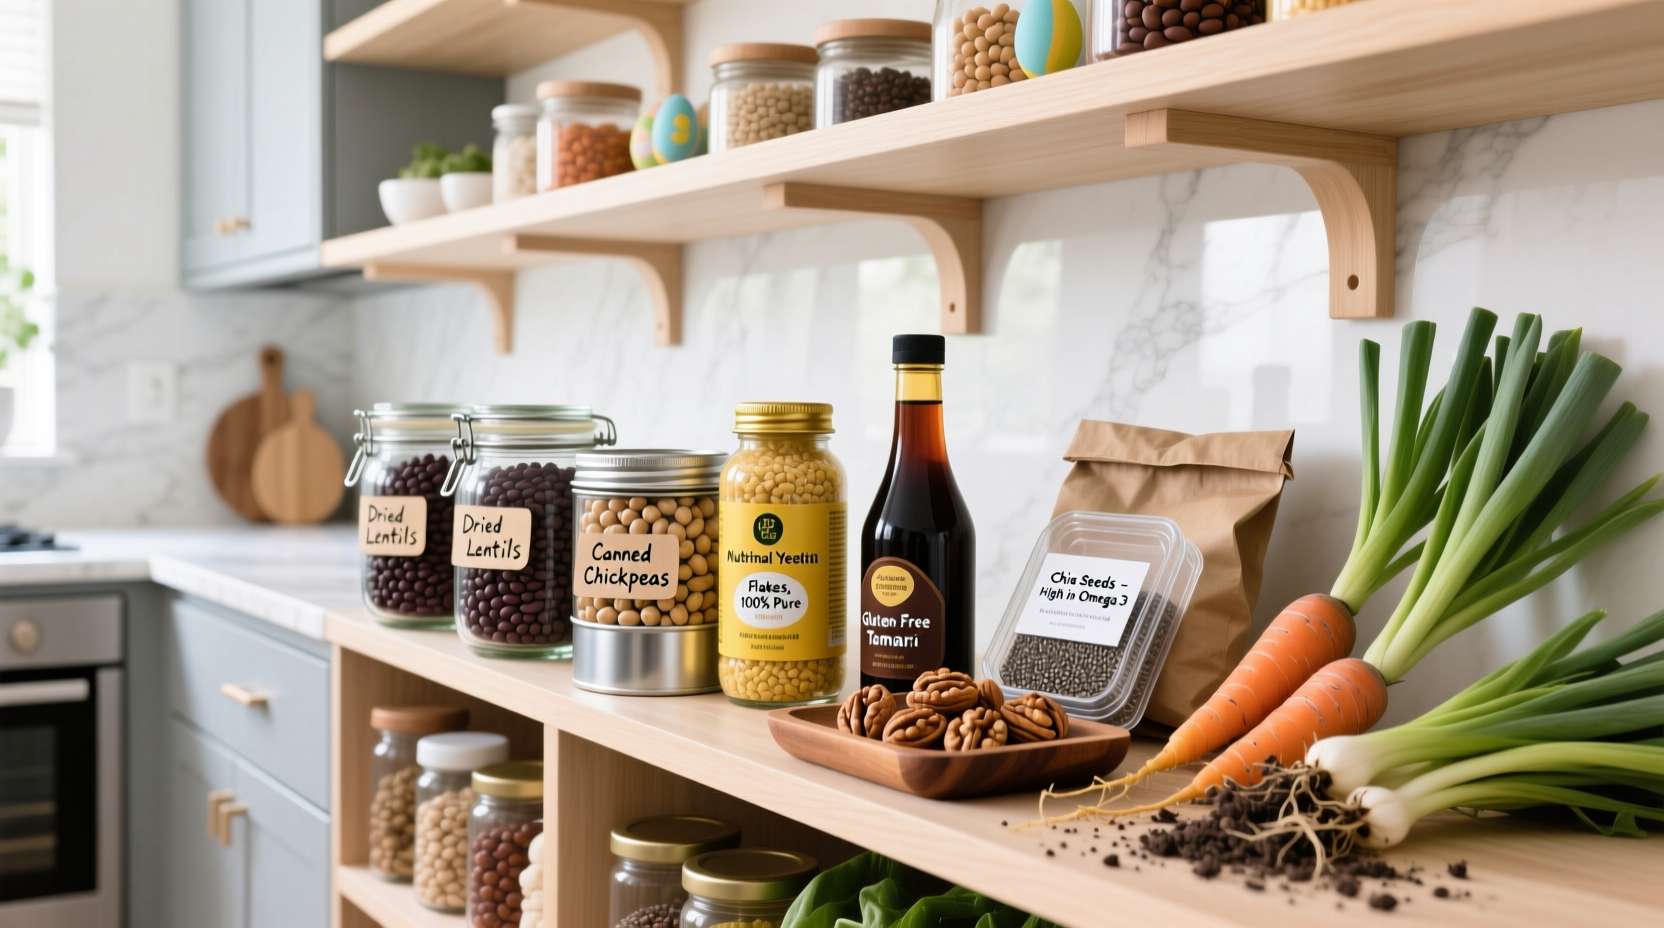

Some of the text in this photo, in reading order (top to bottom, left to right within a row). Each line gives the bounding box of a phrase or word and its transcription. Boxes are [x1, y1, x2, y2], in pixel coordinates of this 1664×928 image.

[368, 504, 405, 523] Dried
[463, 514, 503, 534] Dried
[366, 526, 417, 546] Lentils
[466, 538, 522, 560] Lentils
[592, 542, 652, 563] Canned
[584, 566, 669, 594] Chickpeas
[748, 580, 791, 595] Flakes,
[1050, 571, 1077, 585] Chia
[1079, 574, 1116, 590] Seeds
[741, 596, 802, 609] 100% Pure
[1066, 589, 1076, 601] in
[1078, 590, 1117, 609] Omega
[1119, 594, 1129, 607] 3
[900, 613, 931, 629] Free
